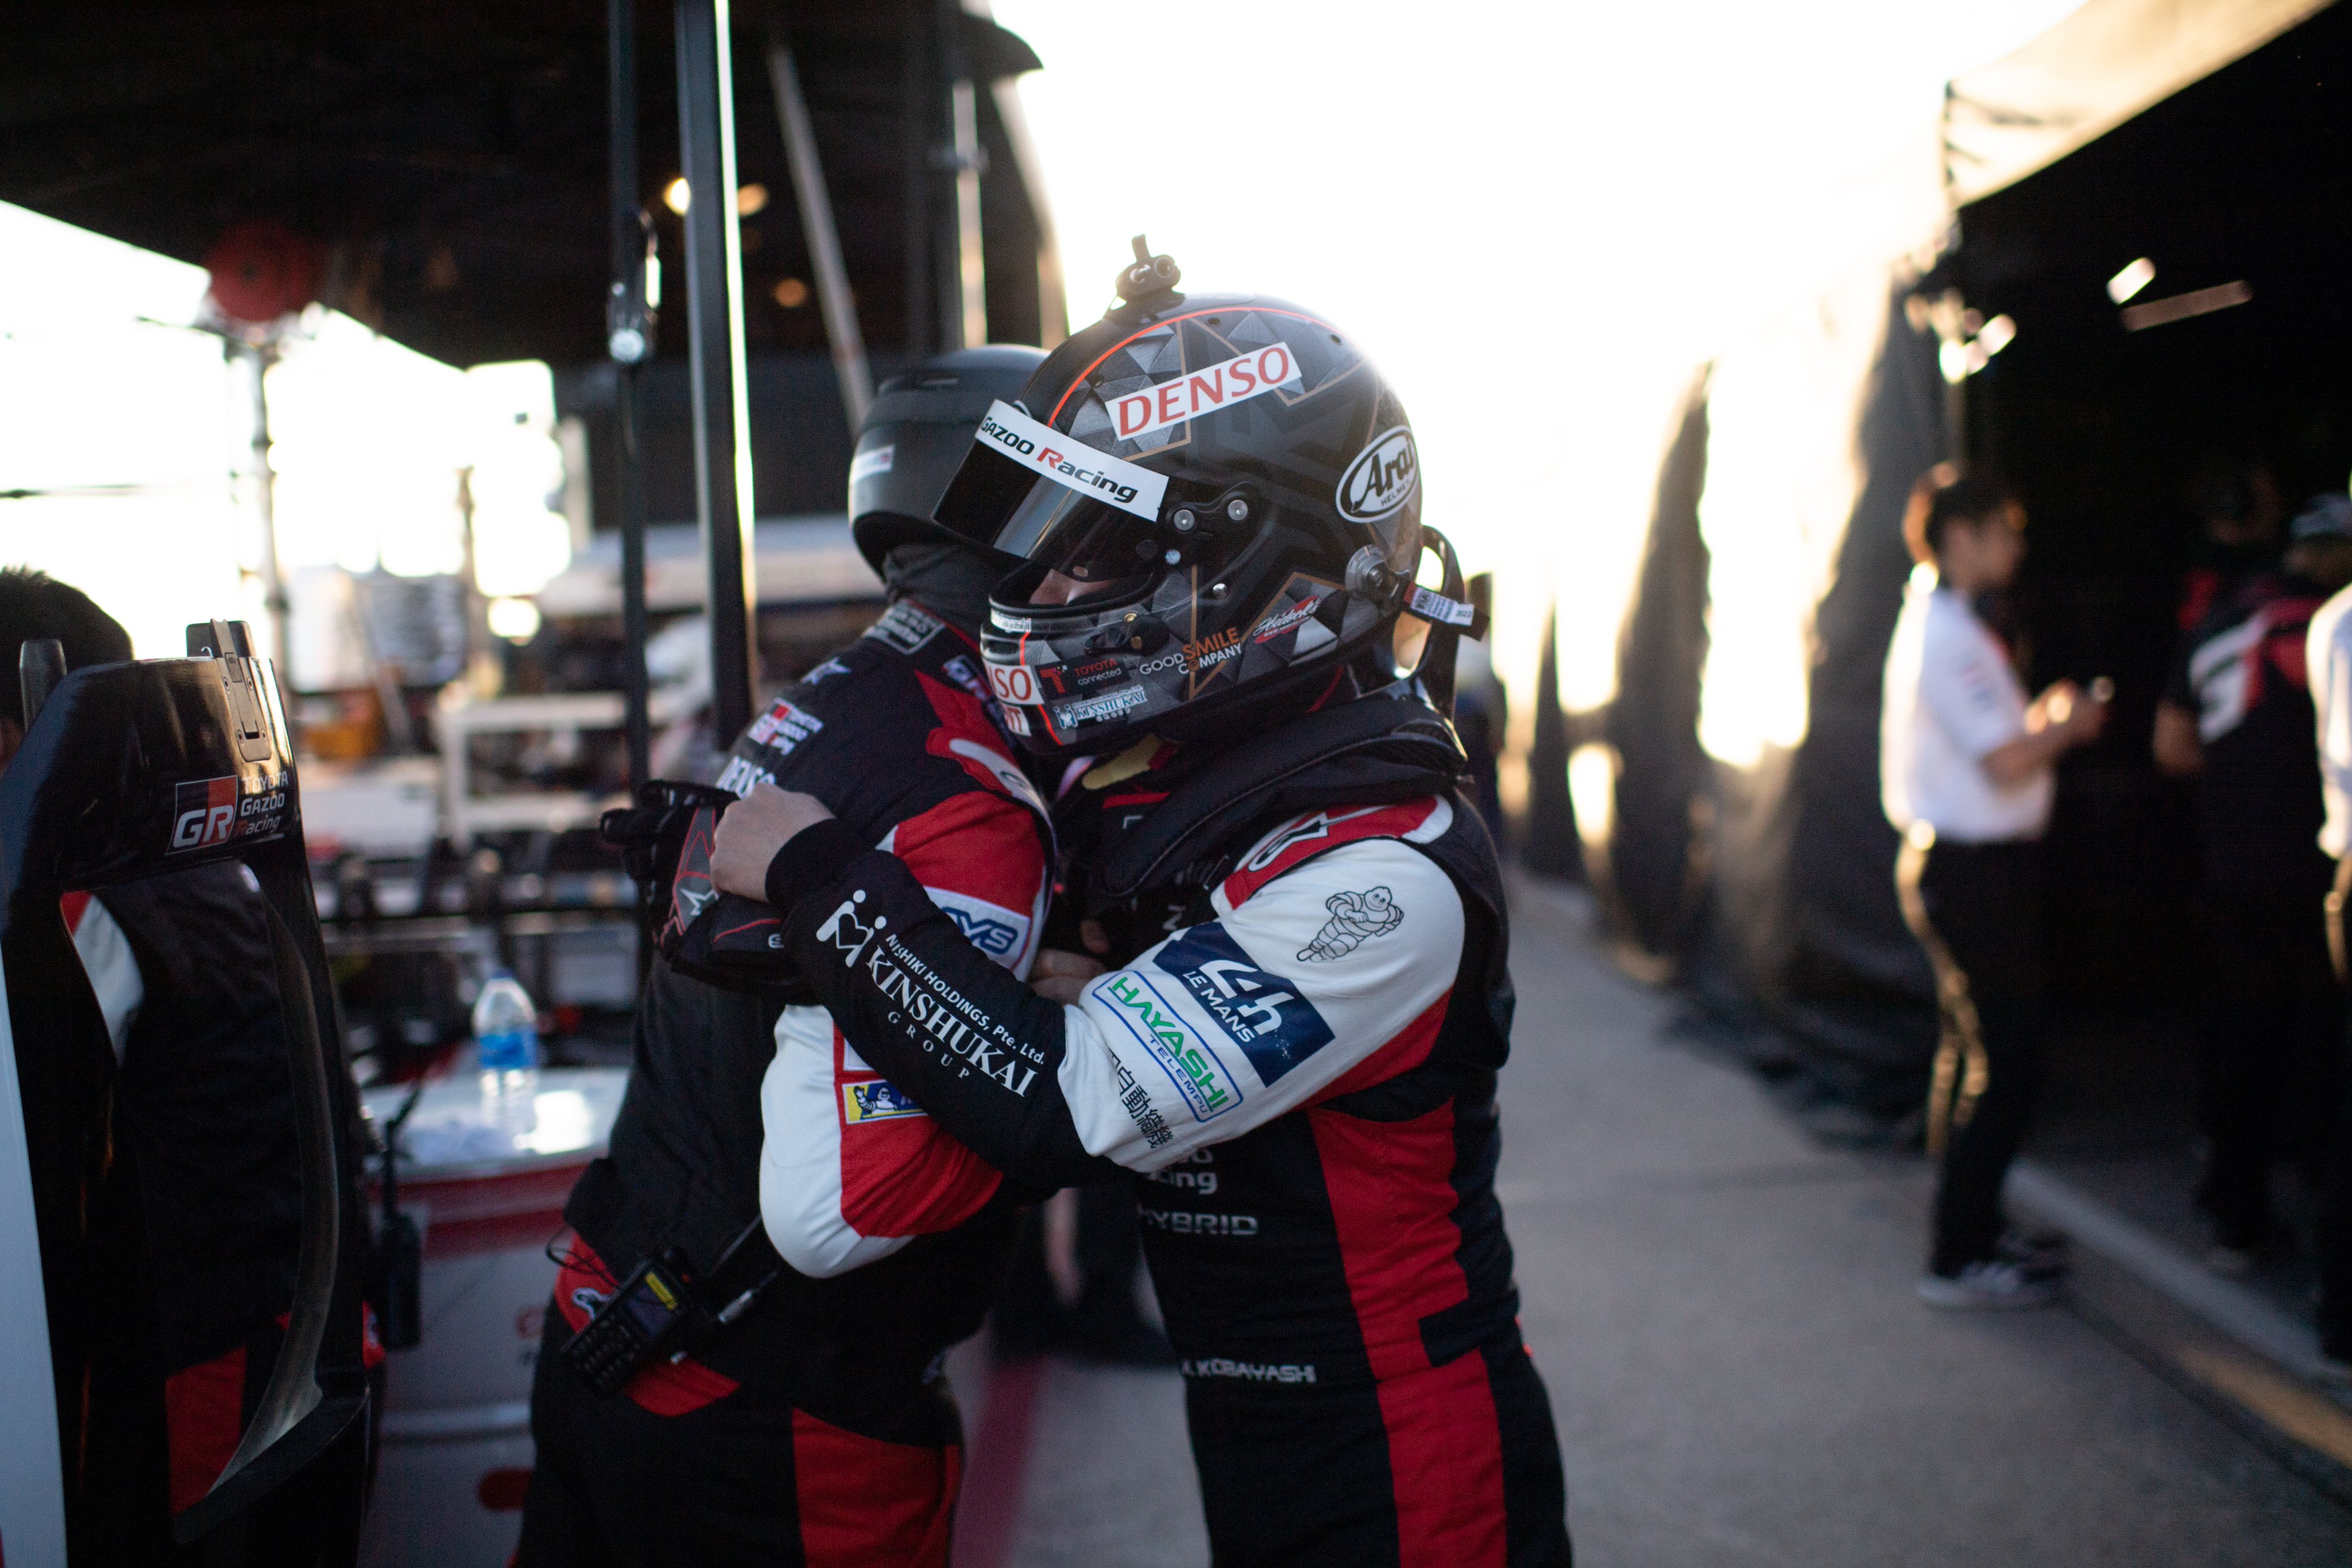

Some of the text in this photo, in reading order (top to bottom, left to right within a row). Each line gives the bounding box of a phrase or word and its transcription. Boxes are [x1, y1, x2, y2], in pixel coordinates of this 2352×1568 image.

[1117, 347, 1289, 436] DENSO
[981, 416, 1138, 504] GAZOO Racing
[1351, 441, 1414, 512] Arai
[1074, 659, 1117, 677] TOYOTA
[1078, 668, 1121, 685] connected
[1139, 628, 1240, 675] GOOD SMILE
[1178, 643, 1241, 674] COMPANY
[989, 666, 1032, 701] SO
[1077, 691, 1146, 719] KINSHUKAI
[241, 793, 285, 817] GAZOO
[242, 771, 289, 794] TOYOTA
[173, 804, 234, 849] GR
[235, 814, 281, 837] Racing
[865, 945, 1037, 1097] KINSHUKAI
[885, 934, 1045, 1064] NISHIKI HOLDINGS, Pte. Ltd.
[1182, 971, 1255, 1043] LE MANS
[888, 1011, 969, 1078] GROUP
[1112, 977, 1228, 1108] HAYASHI
[1108, 1046, 1173, 1149] 自動織機
[1150, 1034, 1208, 1113] TELEMPU
